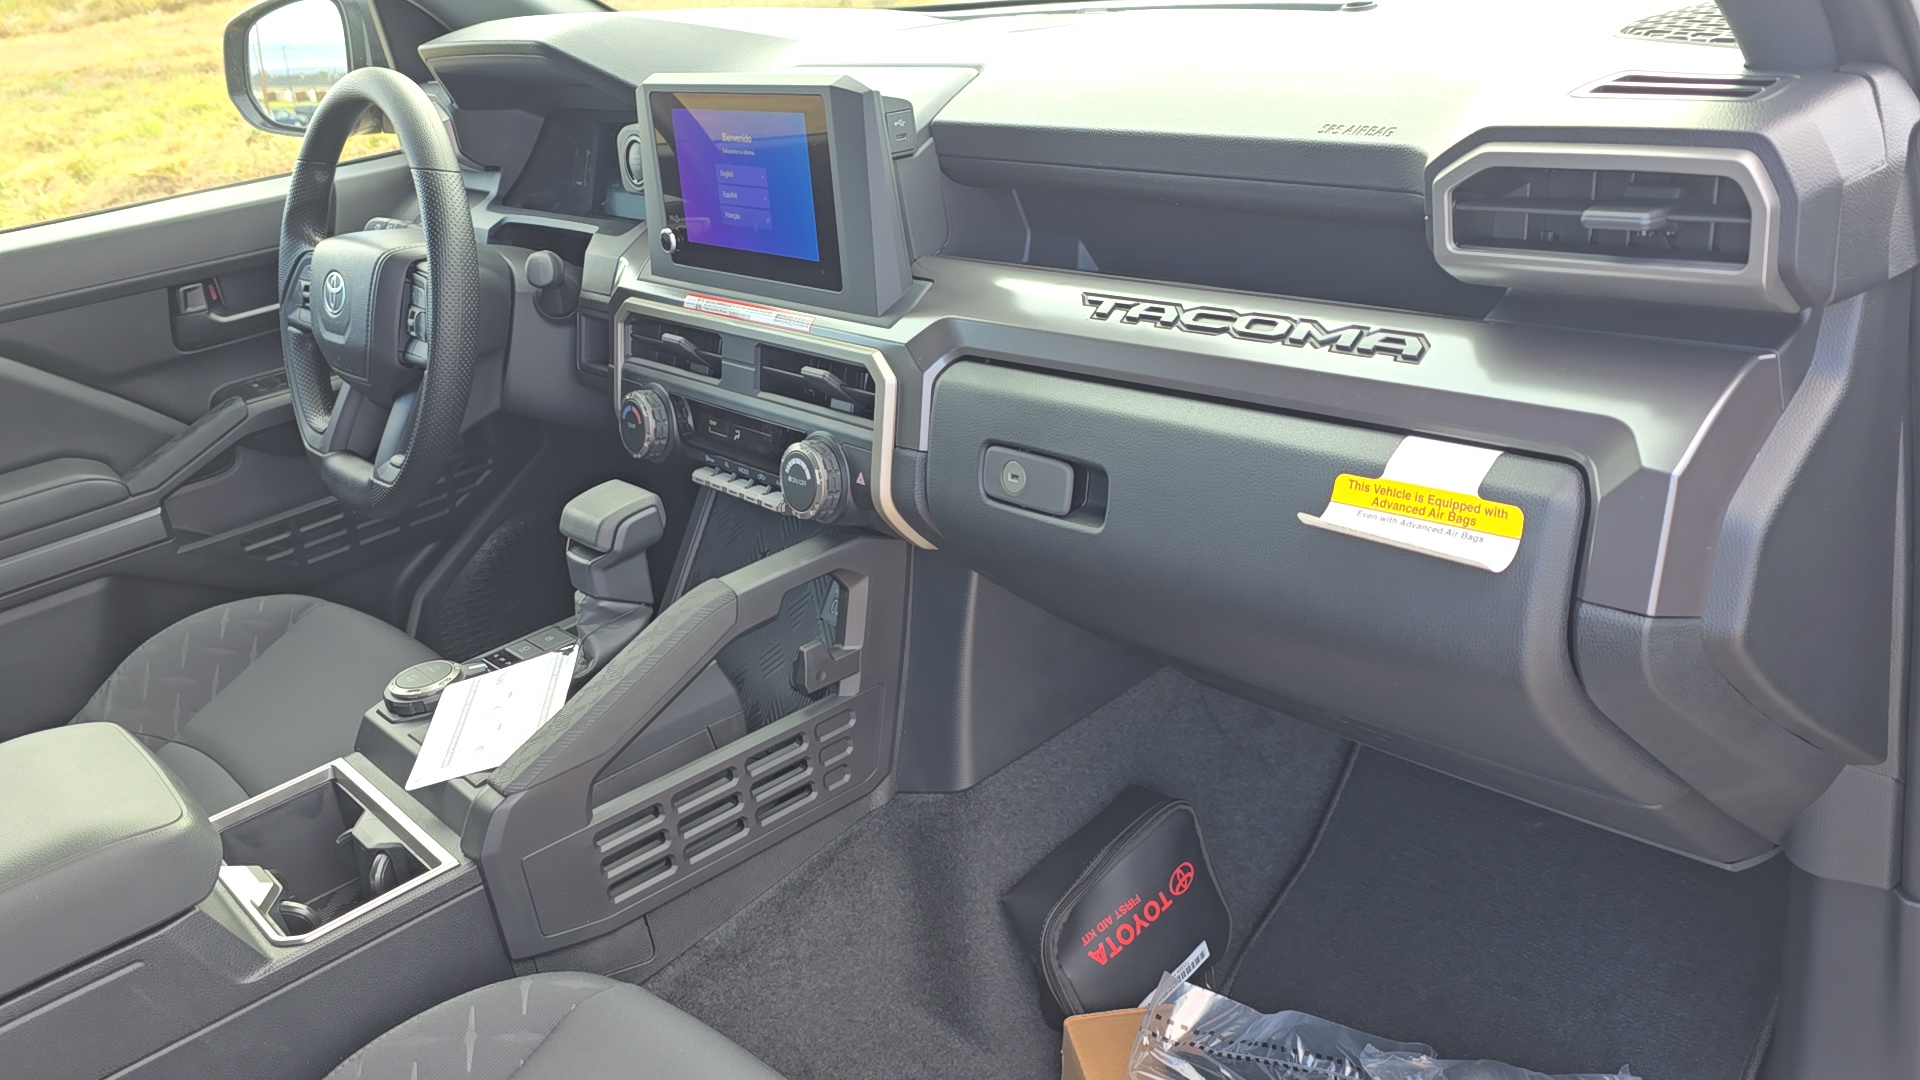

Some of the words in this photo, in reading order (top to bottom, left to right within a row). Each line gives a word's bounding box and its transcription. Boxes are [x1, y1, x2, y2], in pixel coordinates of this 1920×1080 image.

[1082, 292, 1431, 364] TACOMA
[1348, 479, 1370, 493] This
[1374, 484, 1411, 501] Vehicle
[1414, 491, 1425, 503] is
[1428, 494, 1482, 515] Equipped
[1484, 507, 1509, 520] with
[1371, 496, 1426, 516] Advanced
[1428, 508, 1444, 520] Air
[1448, 511, 1477, 528] Bags
[1356, 509, 1378, 520] Even
[1380, 514, 1398, 525] with
[1400, 519, 1444, 535] Advanced
[1445, 528, 1460, 538] Air
[1461, 531, 1485, 544] Bags
[1096, 914, 1113, 933] AID
[1114, 894, 1142, 920] FIRST
[1081, 928, 1097, 947] KIT
[1087, 891, 1173, 966] TOYOTA
